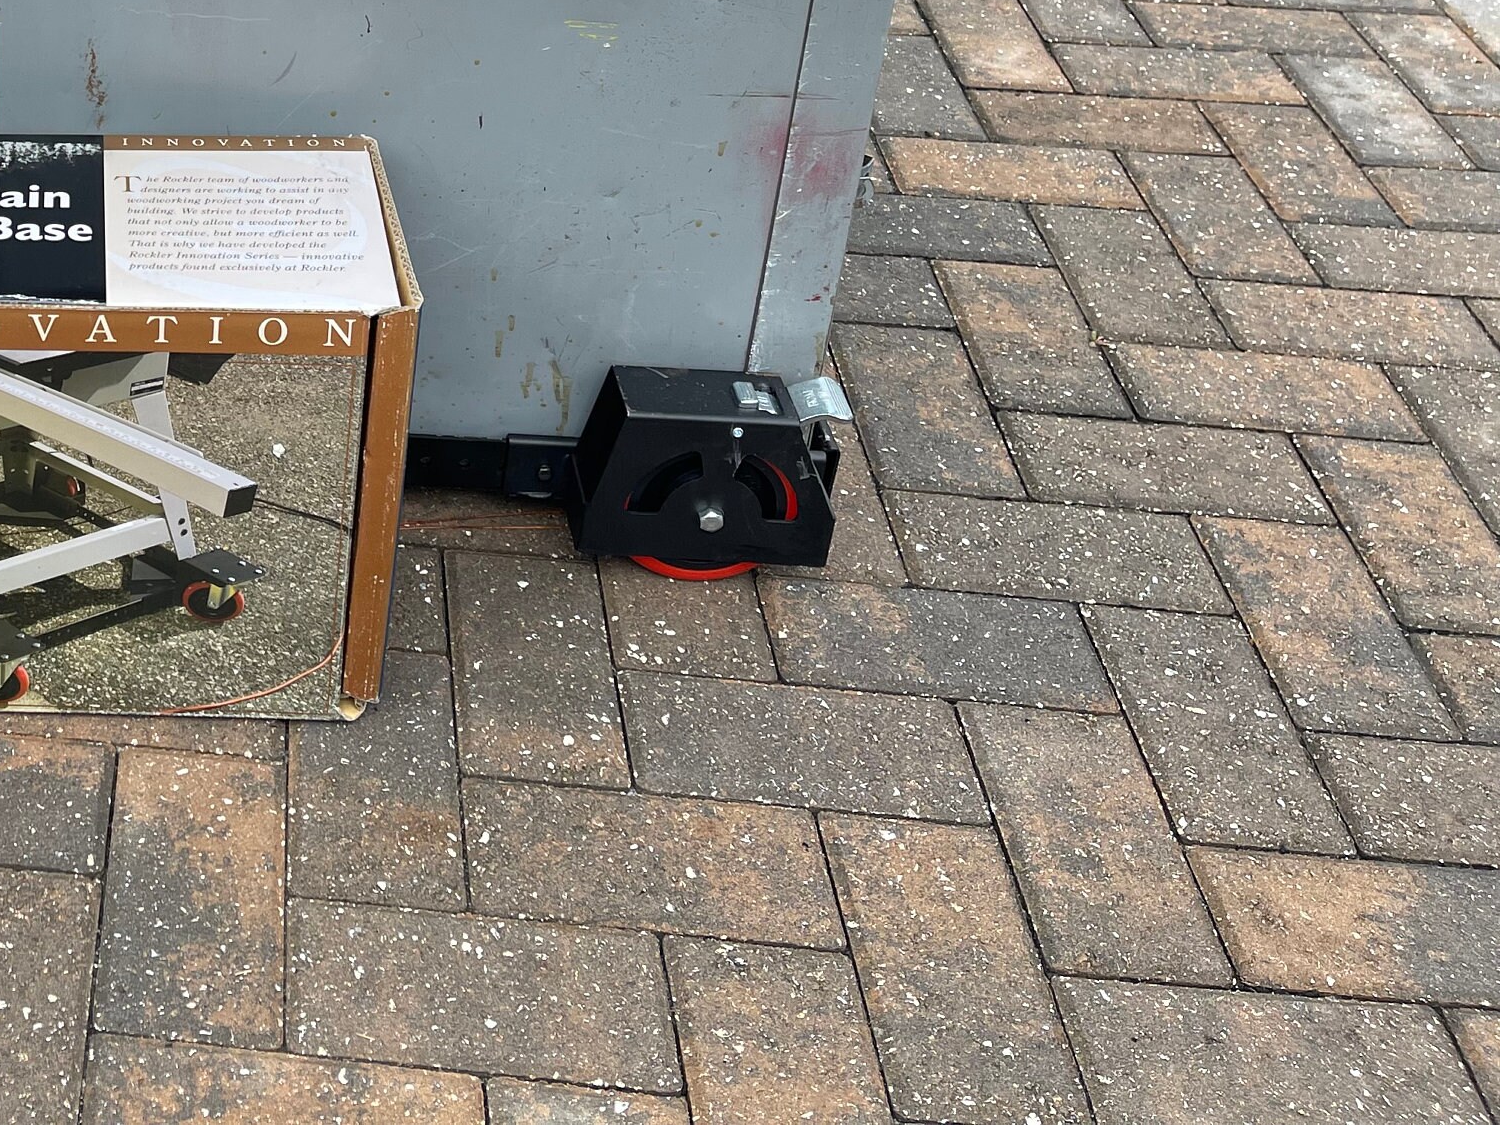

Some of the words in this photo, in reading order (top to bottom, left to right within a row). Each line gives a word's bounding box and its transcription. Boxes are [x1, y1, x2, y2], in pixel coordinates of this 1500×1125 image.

[121, 137, 346, 148] INNOVATION
[163, 176, 203, 184] Rockler
[207, 176, 235, 184] team
[238, 176, 251, 184] of
[252, 176, 324, 184] woodworkers
[140, 186, 192, 194] designers
[217, 186, 262, 195] working
[127, 197, 201, 205] woodworking
[204, 197, 242, 205] project
[308, 197, 321, 205] of
[182, 207, 198, 215] We
[250, 208, 292, 216] develop
[296, 208, 344, 216] products
[175, 218, 200, 227] only
[202, 218, 234, 226] allow
[213, 229, 232, 237] but
[268, 230, 315, 238] efficient
[129, 240, 157, 248] That
[173, 240, 196, 249] why
[249, 241, 306, 250] developed
[309, 241, 327, 249] the
[129, 251, 173, 259] Rockler
[176, 251, 241, 260] Innovation
[244, 252, 280, 260] Series
[301, 252, 365, 261] innovative
[128, 263, 179, 271] products
[181, 263, 216, 271] found
[219, 263, 282, 272] exclusively
[284, 264, 298, 272] at
